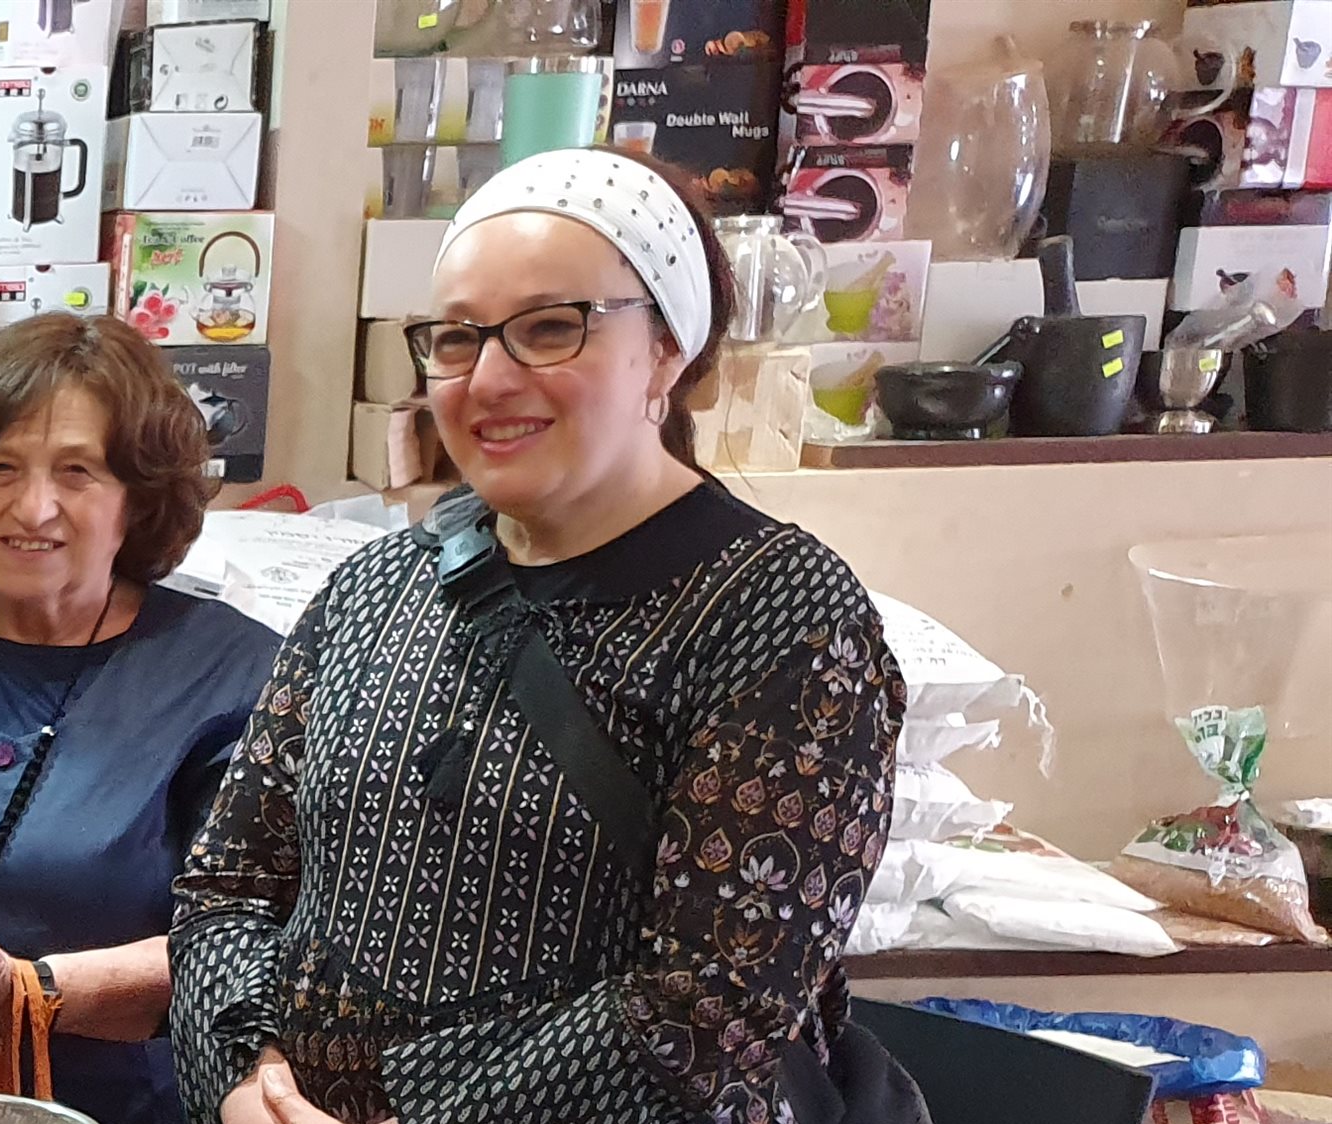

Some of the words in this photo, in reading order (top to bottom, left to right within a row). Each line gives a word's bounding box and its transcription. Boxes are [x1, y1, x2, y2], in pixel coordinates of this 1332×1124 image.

[616, 81, 668, 96] DARNA
[666, 113, 716, 127] Double
[718, 111, 749, 125] Wall
[732, 125, 769, 139] Mugs
